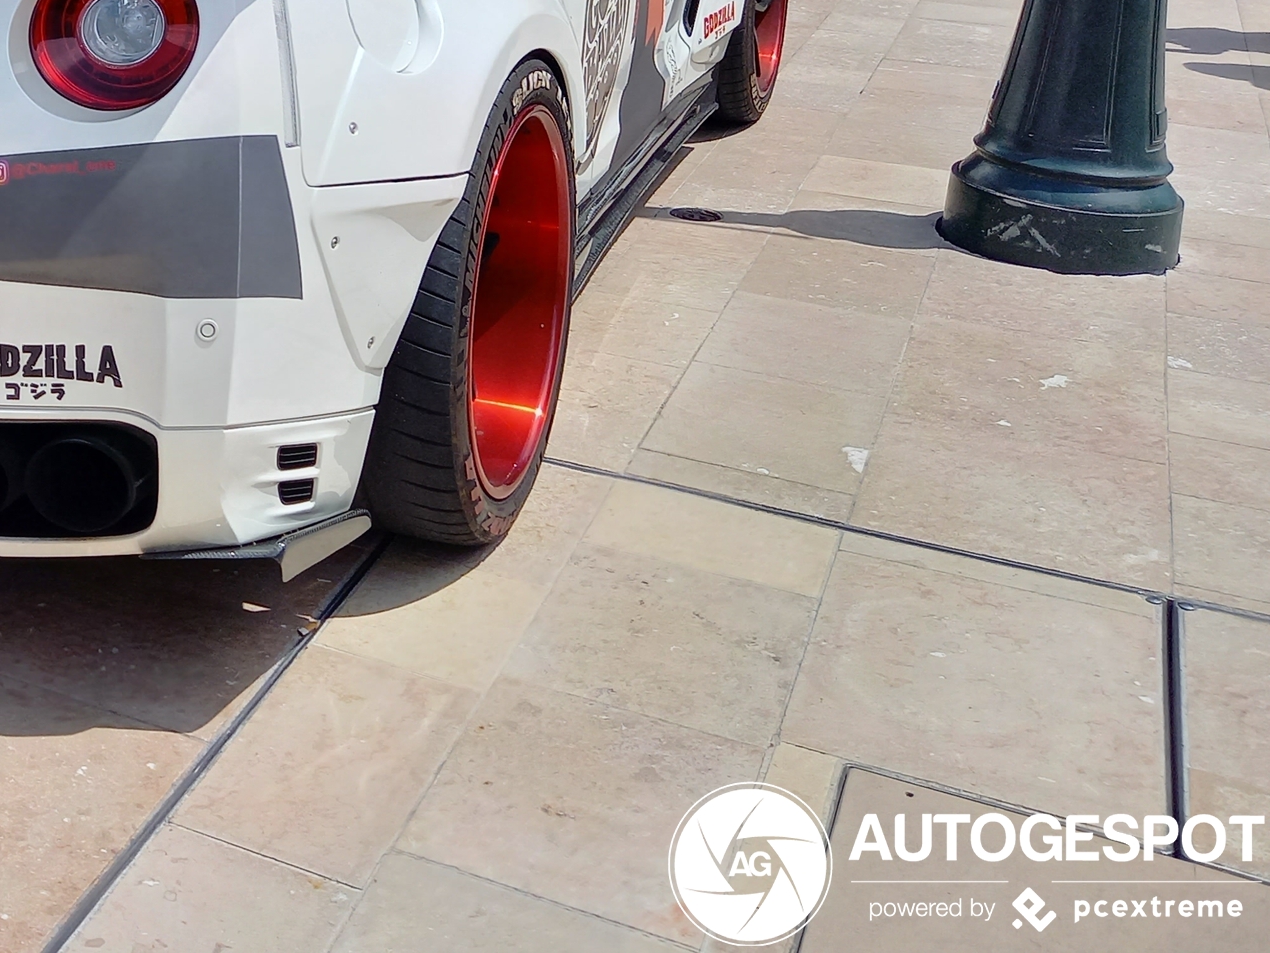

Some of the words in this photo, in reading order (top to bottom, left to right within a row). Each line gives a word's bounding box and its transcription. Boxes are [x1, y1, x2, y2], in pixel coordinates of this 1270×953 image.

[703, 1, 735, 39] GODZILLA
[5, 382, 66, 401] ゴジラ
